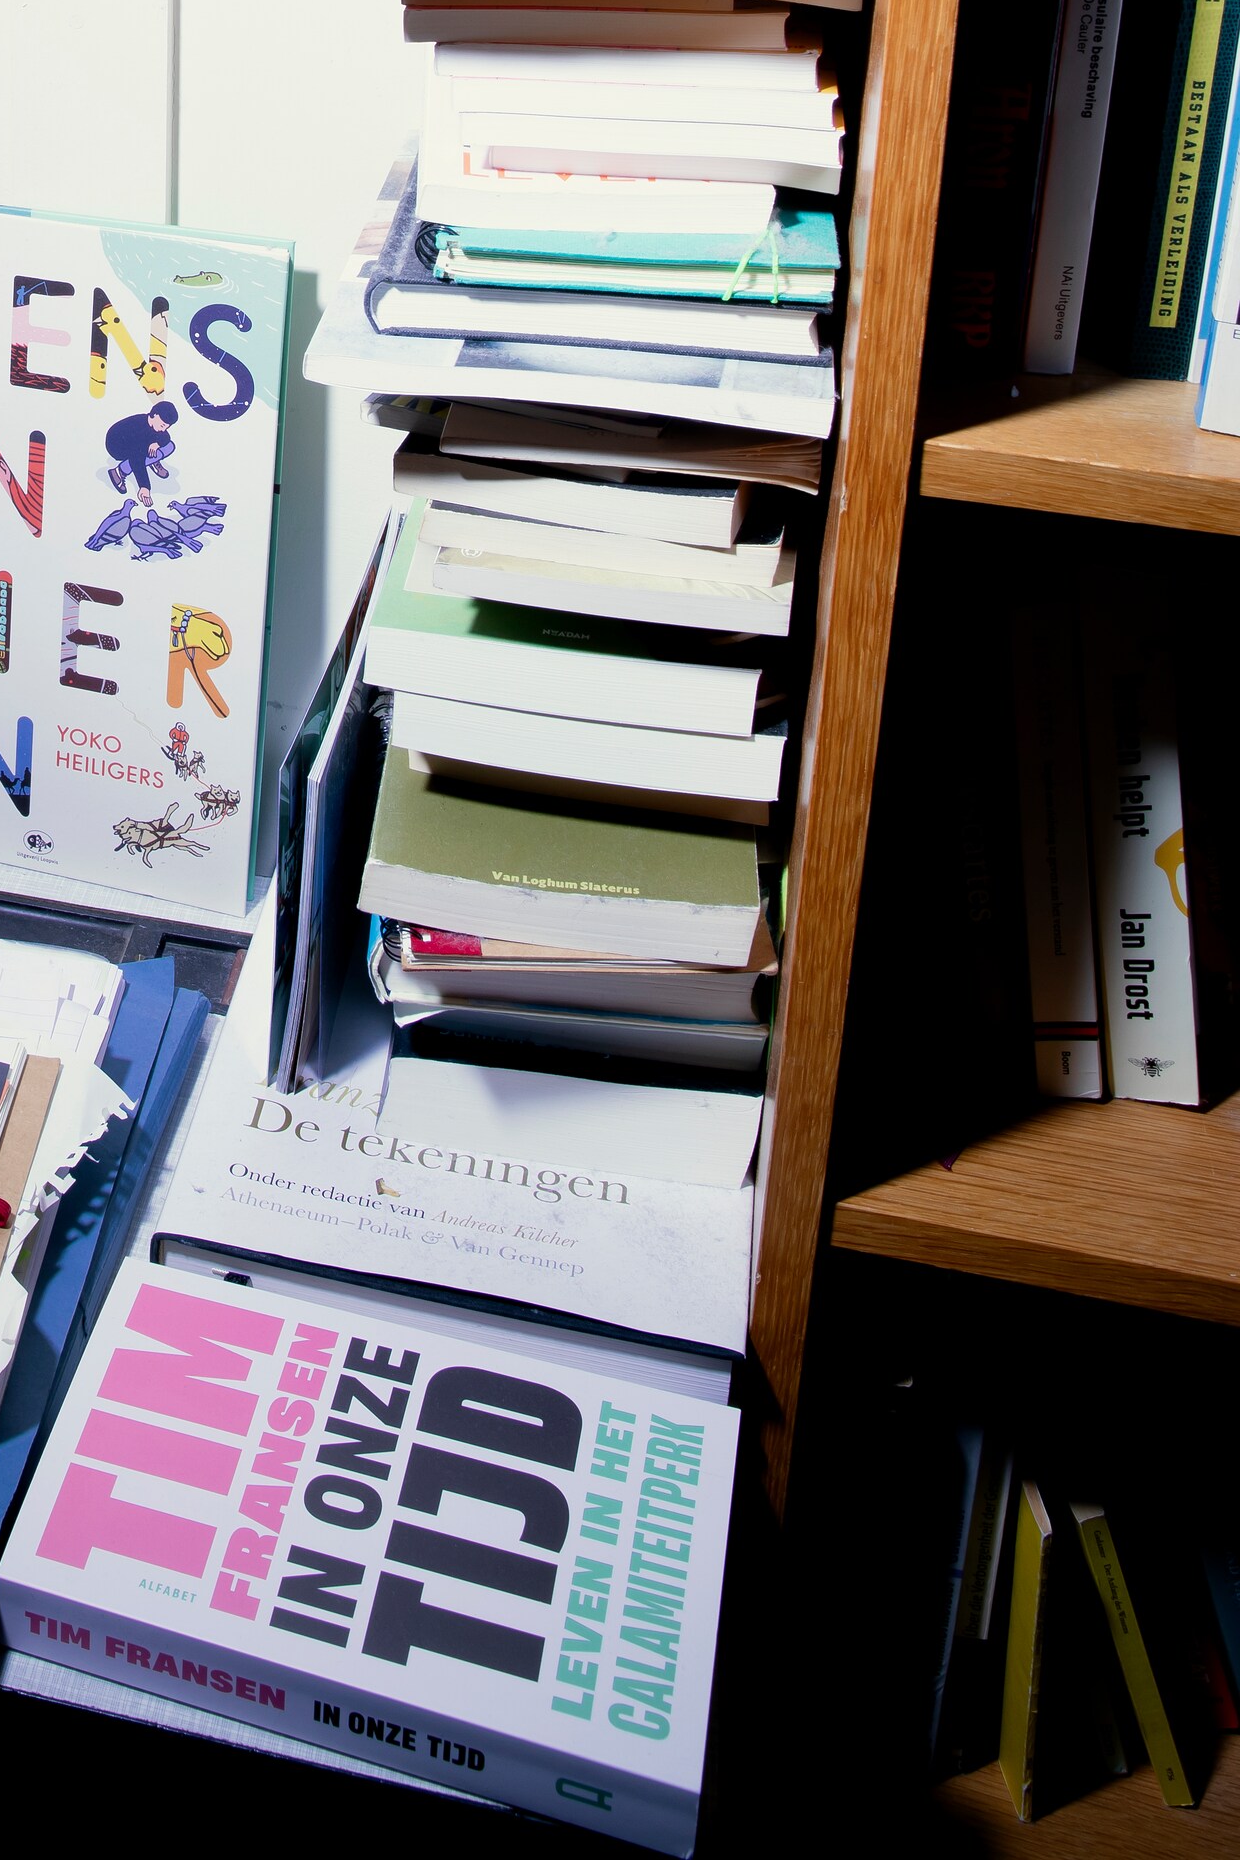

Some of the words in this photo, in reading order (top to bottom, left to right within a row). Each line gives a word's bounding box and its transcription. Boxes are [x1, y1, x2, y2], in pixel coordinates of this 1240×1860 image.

[1077, 13, 1094, 54] Cauter
[1080, 46, 1105, 119] beschaving
[1180, 80, 1206, 164] BESTAAN
[1175, 172, 1193, 206] ALS
[1157, 214, 1186, 319] VERLEIDING
[1054, 289, 1072, 341] Uitgevers
[55, 750, 164, 789] HEILIGERS
[56, 724, 122, 755] YOKO
[1113, 774, 1153, 839] helpt
[492, 870, 520, 883] Van
[522, 874, 578, 892] Loghum
[580, 881, 640, 896] Slaterus
[1119, 908, 1152, 949] Jan
[1122, 958, 1155, 1021] Drost
[1060, 1051, 1071, 1076] Boom
[243, 1095, 321, 1144] De
[340, 1124, 633, 1207] tekeningen
[228, 1160, 296, 1193] Onder
[301, 1179, 383, 1213] redactie
[388, 1201, 427, 1220] van
[433, 1206, 508, 1237] Andreas
[421, 1230, 446, 1245] &
[450, 1233, 492, 1258] Van
[497, 1243, 586, 1278] Gennep
[35, 1282, 286, 1581] TIM
[302, 1335, 422, 1532] ONZE
[590, 1400, 638, 1484] HET
[208, 1320, 340, 1622] FRANSEN
[360, 1364, 584, 1684] TIJD
[580, 1491, 627, 1547] IN
[137, 1577, 198, 1604] ALFABET
[268, 1543, 367, 1650] IN
[606, 1413, 706, 1741] CALAMITEITPERK
[550, 1553, 617, 1722] LEVEN
[24, 1610, 92, 1651] TIM
[104, 1634, 287, 1711] FRANSEN
[312, 1698, 342, 1729] IN
[346, 1709, 418, 1753] ONZE
[426, 1732, 486, 1773] TIJD
